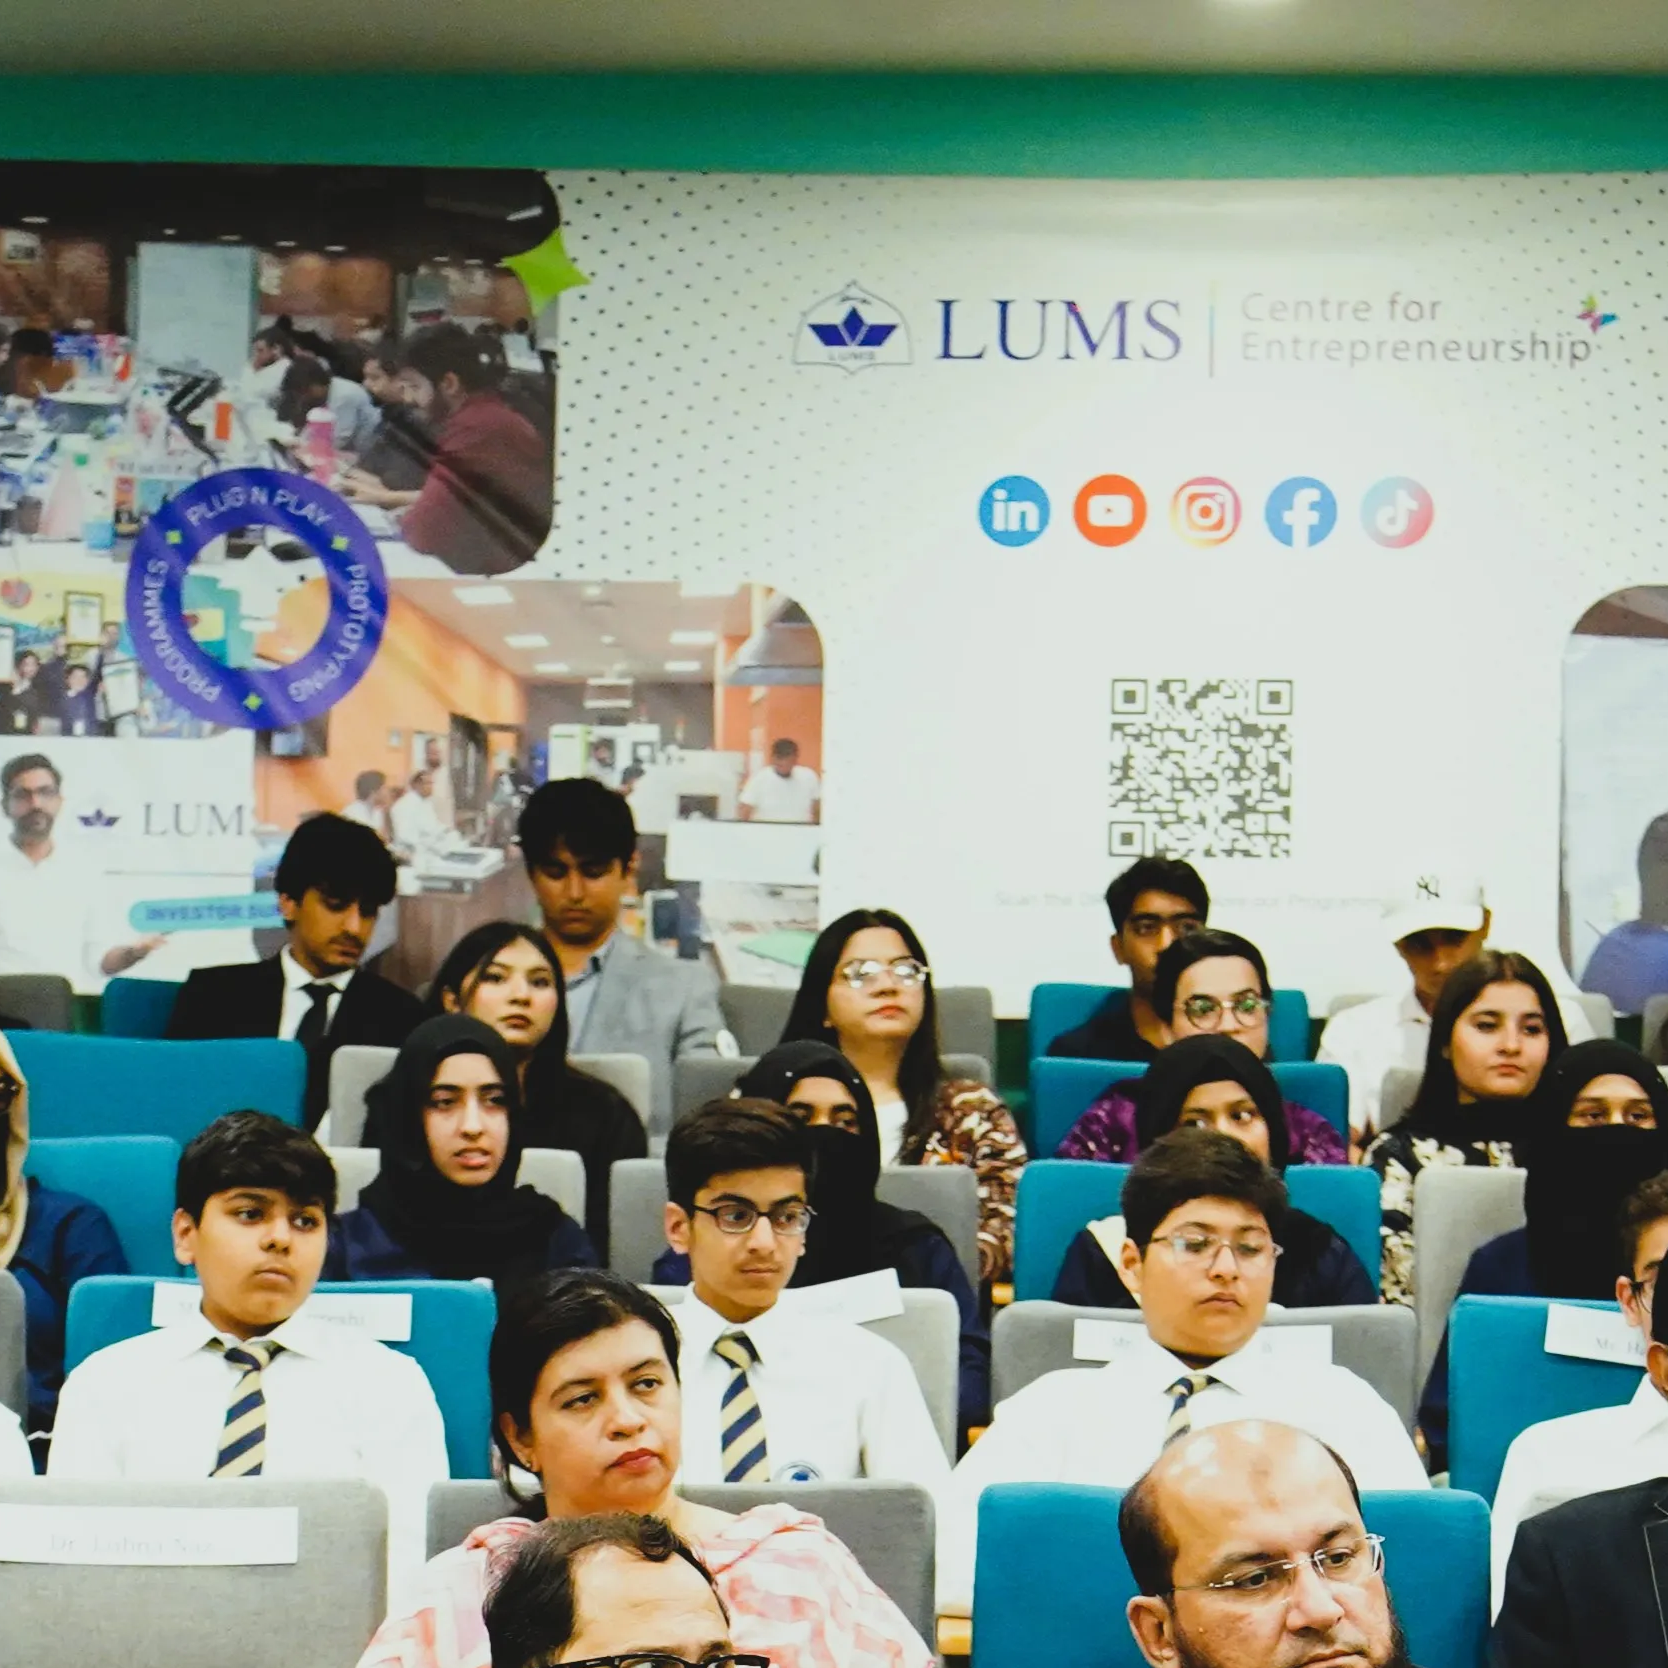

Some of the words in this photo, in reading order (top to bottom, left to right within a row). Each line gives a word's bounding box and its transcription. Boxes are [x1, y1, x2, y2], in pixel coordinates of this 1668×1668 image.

[1241, 292, 1373, 323] Centre
[1388, 291, 1443, 323] for
[934, 299, 1183, 361] LUMS
[1242, 331, 1593, 369] Entrepreneurship
[186, 486, 247, 527] PLUG
[250, 486, 269, 506] N
[273, 488, 333, 527] PLAY
[142, 558, 223, 703] PROGRAMMES
[287, 563, 371, 703] PROTOTYPING
[146, 904, 242, 922] INVESTOR
